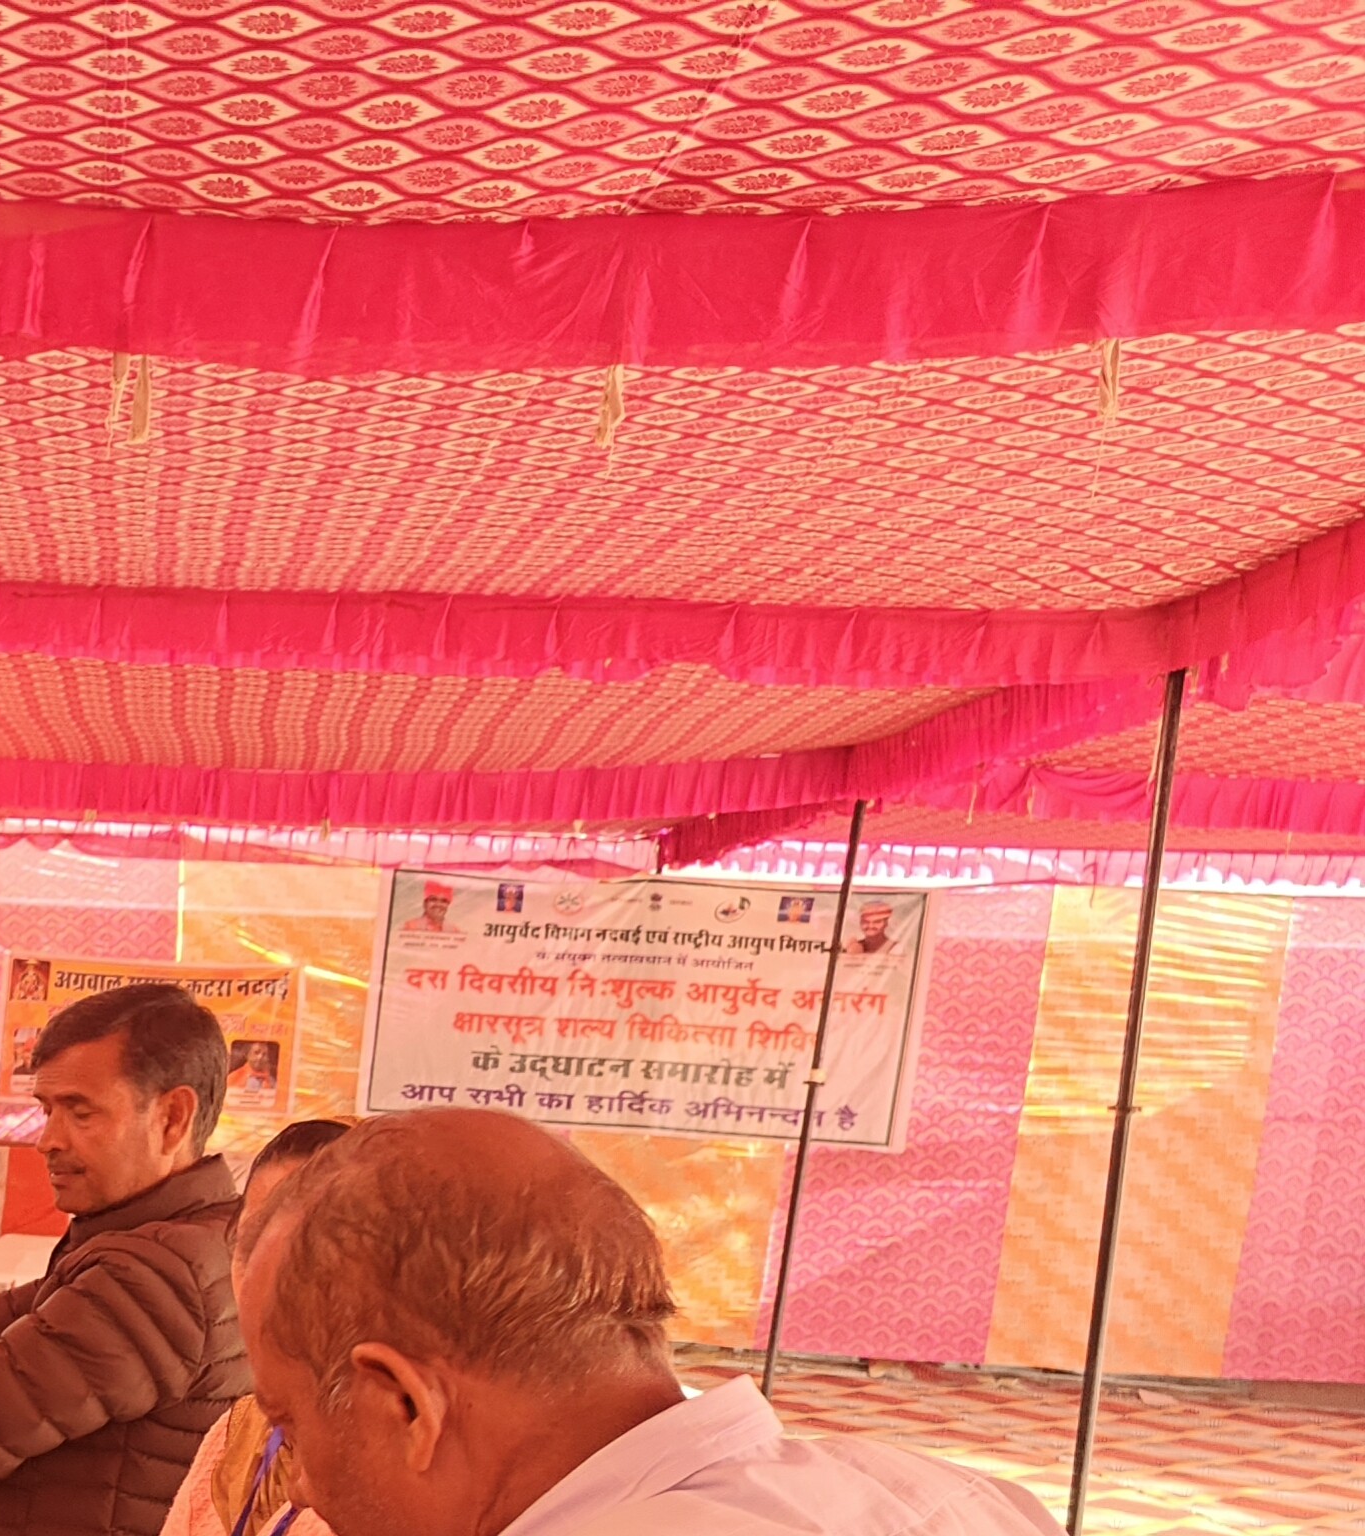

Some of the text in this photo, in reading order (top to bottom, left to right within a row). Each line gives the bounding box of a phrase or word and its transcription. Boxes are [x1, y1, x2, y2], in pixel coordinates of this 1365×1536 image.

[483, 921, 540, 944] आयुर्वेद
[544, 923, 591, 942] विभाग
[595, 925, 641, 945] नदबई
[646, 926, 671, 944] एवं
[673, 929, 724, 950] राष्ट्रीय
[727, 934, 774, 955] आयुष
[779, 934, 825, 954] मिशन
[692, 953, 755, 971] आयोजित
[54, 970, 124, 992] अग्रवाल
[185, 979, 233, 997] कटरा
[237, 971, 290, 1001] नदबई
[405, 968, 450, 991] दस
[457, 964, 559, 997] दिवसीय
[687, 978, 781, 1014] आयुर्वेद
[452, 1011, 545, 1044] क्षारसूत्र
[555, 1017, 617, 1040] शल्य
[627, 1013, 737, 1048] चिकित्सा
[471, 1045, 502, 1072] के
[640, 1058, 757, 1086] समारोह
[763, 1061, 795, 1089] में
[401, 1083, 457, 1103] आप
[466, 1084, 527, 1107] सभी
[536, 1091, 575, 1110] का
[584, 1090, 674, 1114] हार्दिक
[835, 1104, 858, 1131] है
